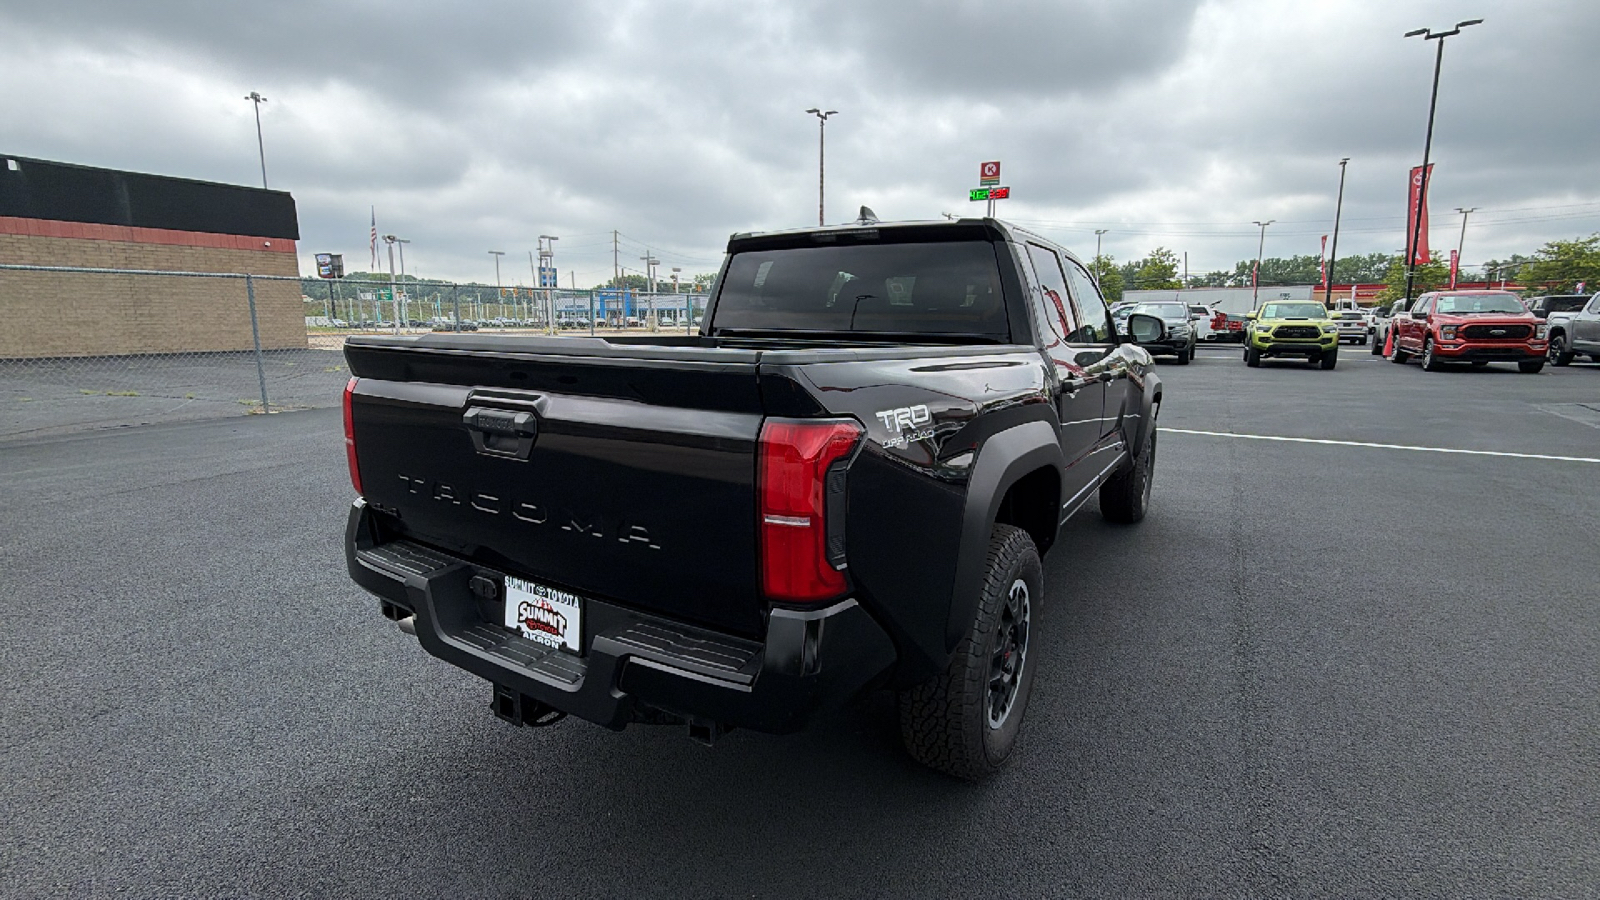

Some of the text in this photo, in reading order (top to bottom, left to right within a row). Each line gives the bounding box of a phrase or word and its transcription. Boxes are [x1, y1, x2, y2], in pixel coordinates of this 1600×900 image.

[479, 417, 514, 430] TOYOTA
[875, 404, 930, 433] TRD
[906, 429, 935, 443] ROAD
[398, 473, 661, 550] TACOMA
[504, 575, 579, 609] SUMMIT TOYOTA
[519, 603, 566, 636] SUMMIT
[537, 623, 558, 635] TOYOTA
[523, 631, 559, 650] AKRON
